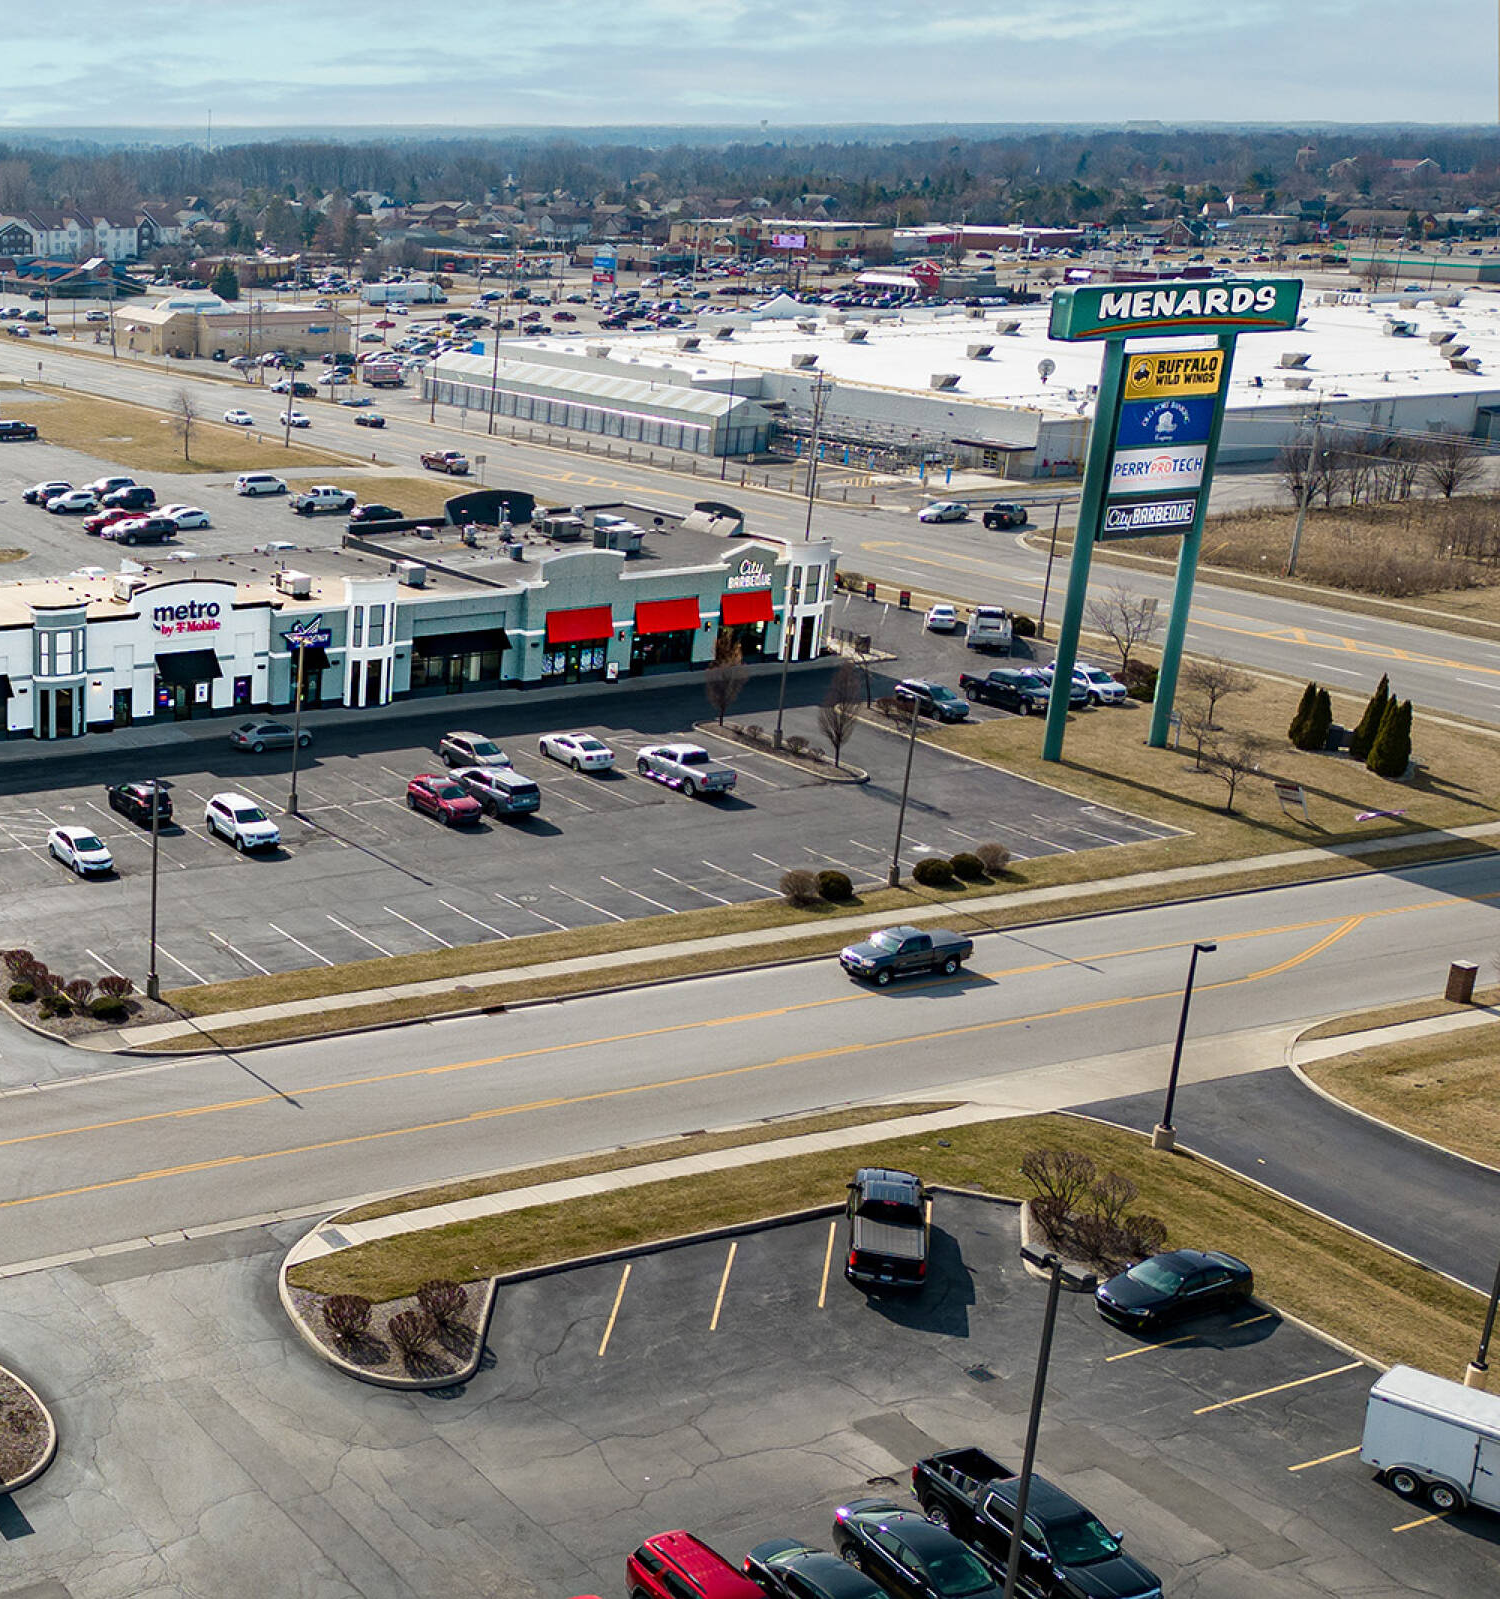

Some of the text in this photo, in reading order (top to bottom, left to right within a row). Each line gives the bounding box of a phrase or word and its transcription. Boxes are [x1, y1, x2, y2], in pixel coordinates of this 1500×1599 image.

[1099, 286, 1276, 319] MENARDS
[1157, 357, 1219, 374] BUFFALO
[1156, 372, 1216, 386] WILD WINGS
[740, 559, 764, 576] City
[154, 600, 220, 621] metro
[161, 623, 174, 637] by
[187, 619, 221, 632] Mobile
